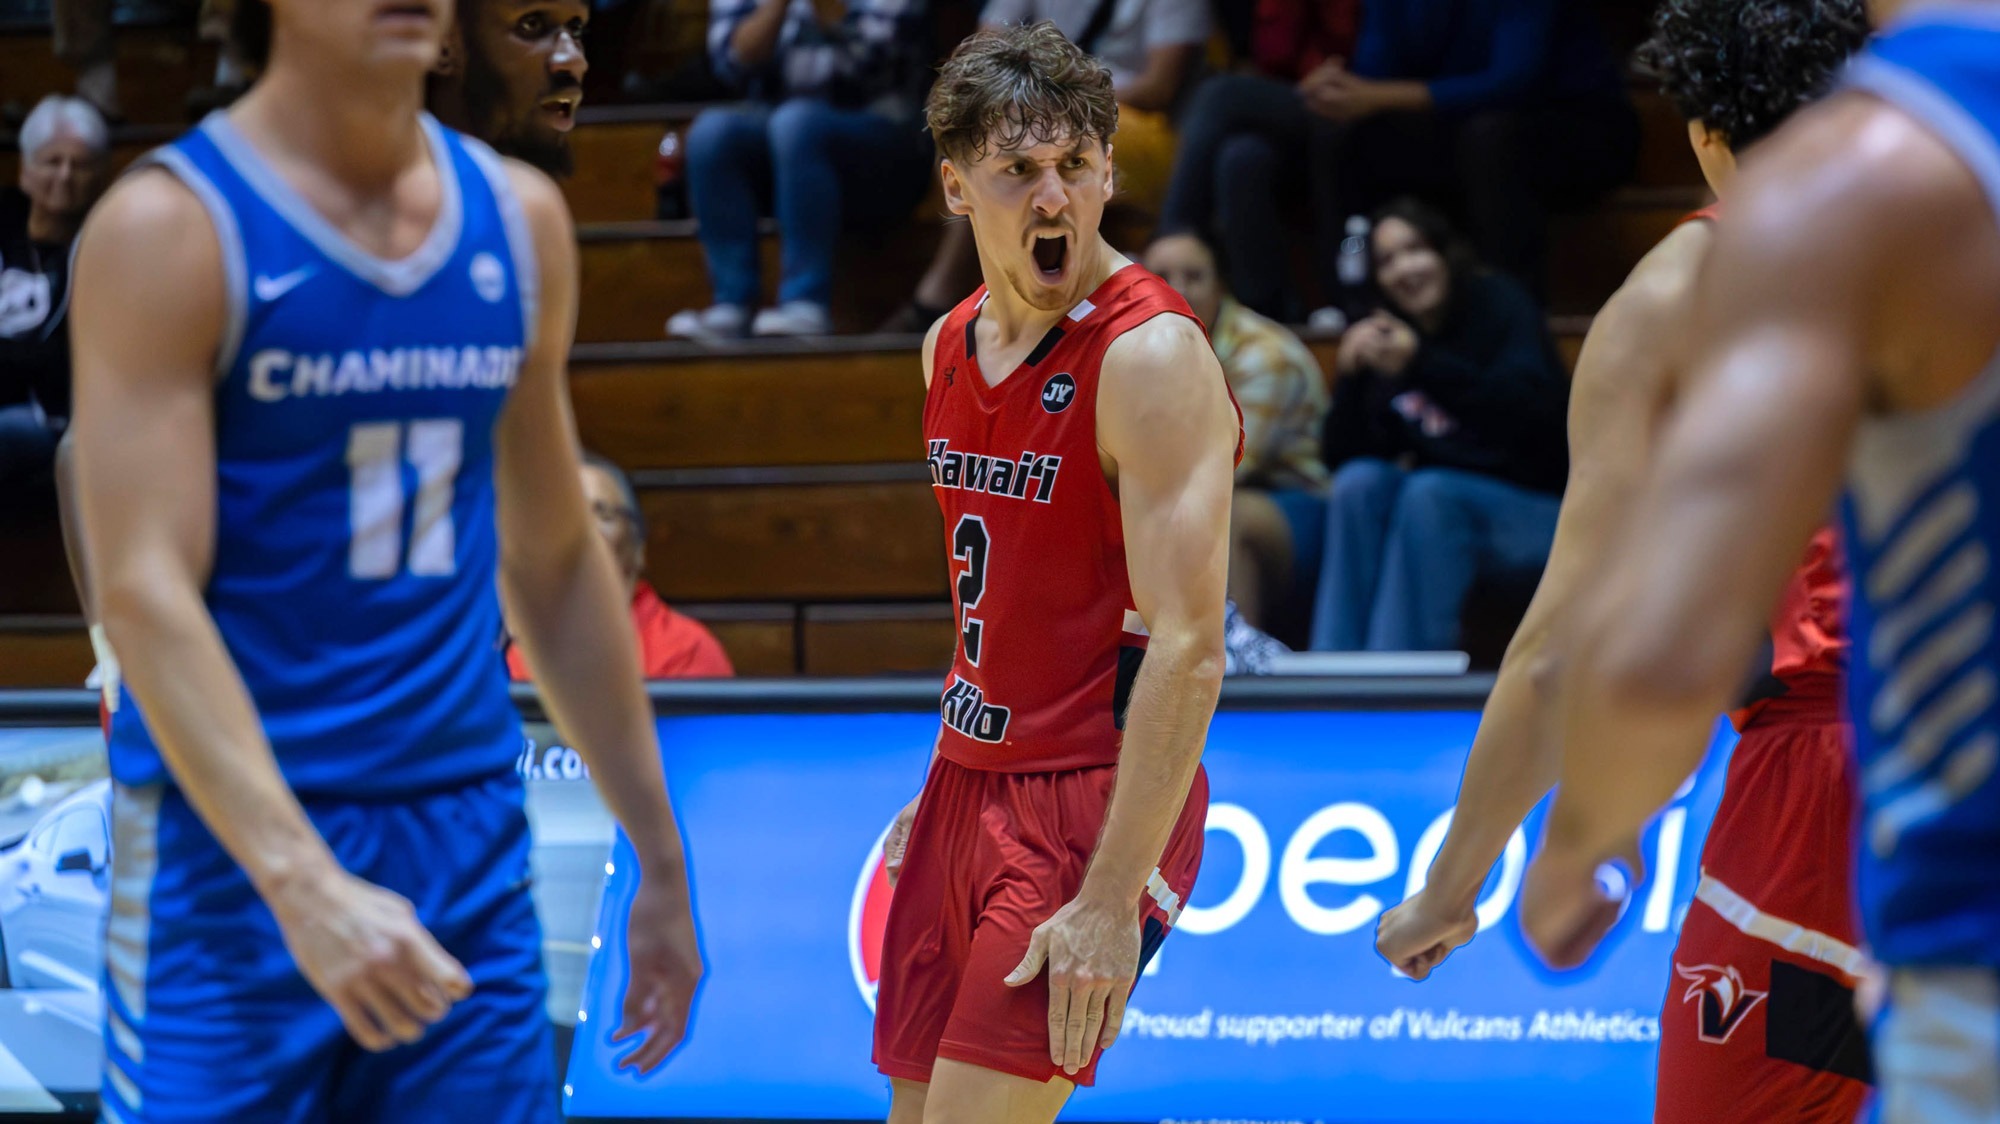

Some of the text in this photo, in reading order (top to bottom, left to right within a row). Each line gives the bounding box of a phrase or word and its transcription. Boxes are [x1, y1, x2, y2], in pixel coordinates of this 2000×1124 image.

[1043, 382, 1074, 403] JY
[346, 418, 463, 580] 11
[953, 513, 991, 668] 2
[941, 673, 1011, 744] Hilo
[1121, 1005, 1661, 1046] Proud supporter of Vulcans Athletics
